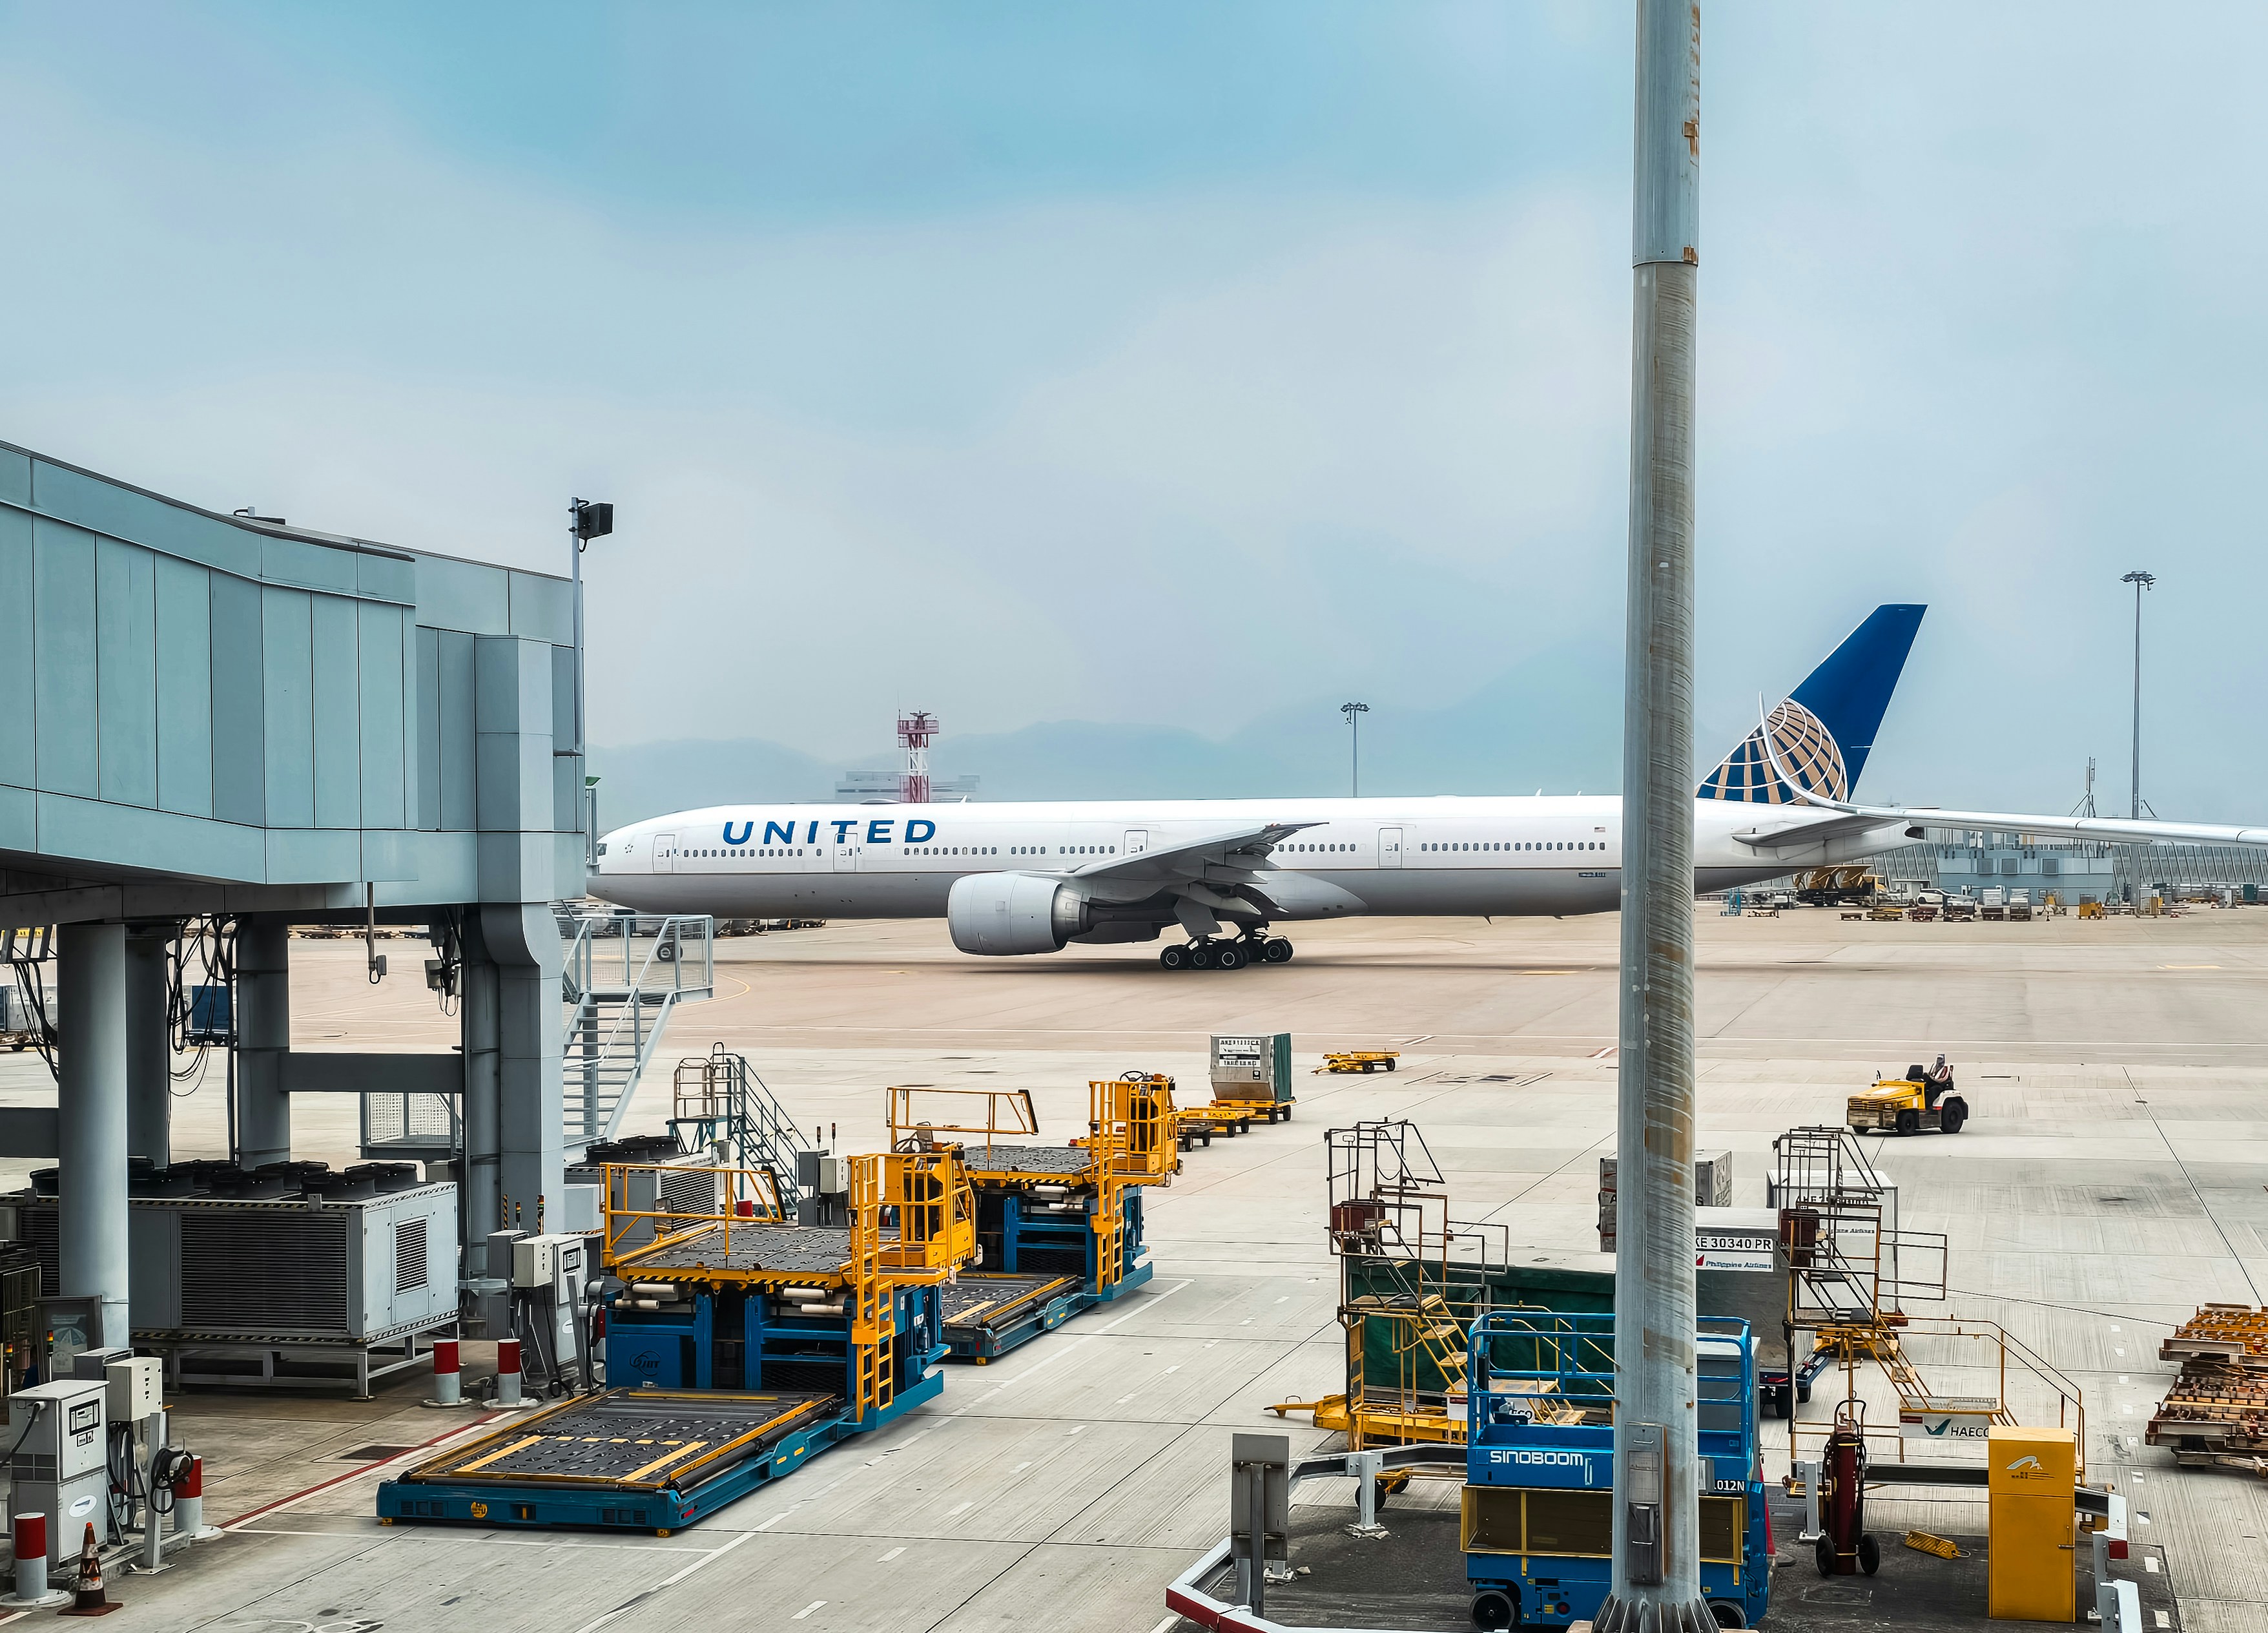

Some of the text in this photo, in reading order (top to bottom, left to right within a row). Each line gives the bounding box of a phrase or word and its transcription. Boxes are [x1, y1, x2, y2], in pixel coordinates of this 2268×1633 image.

[723, 820, 936, 845] UNITED
[1711, 1238, 1752, 1249] 30340
[1755, 1238, 1771, 1250] PR
[1715, 1480, 1745, 1491] 012N
